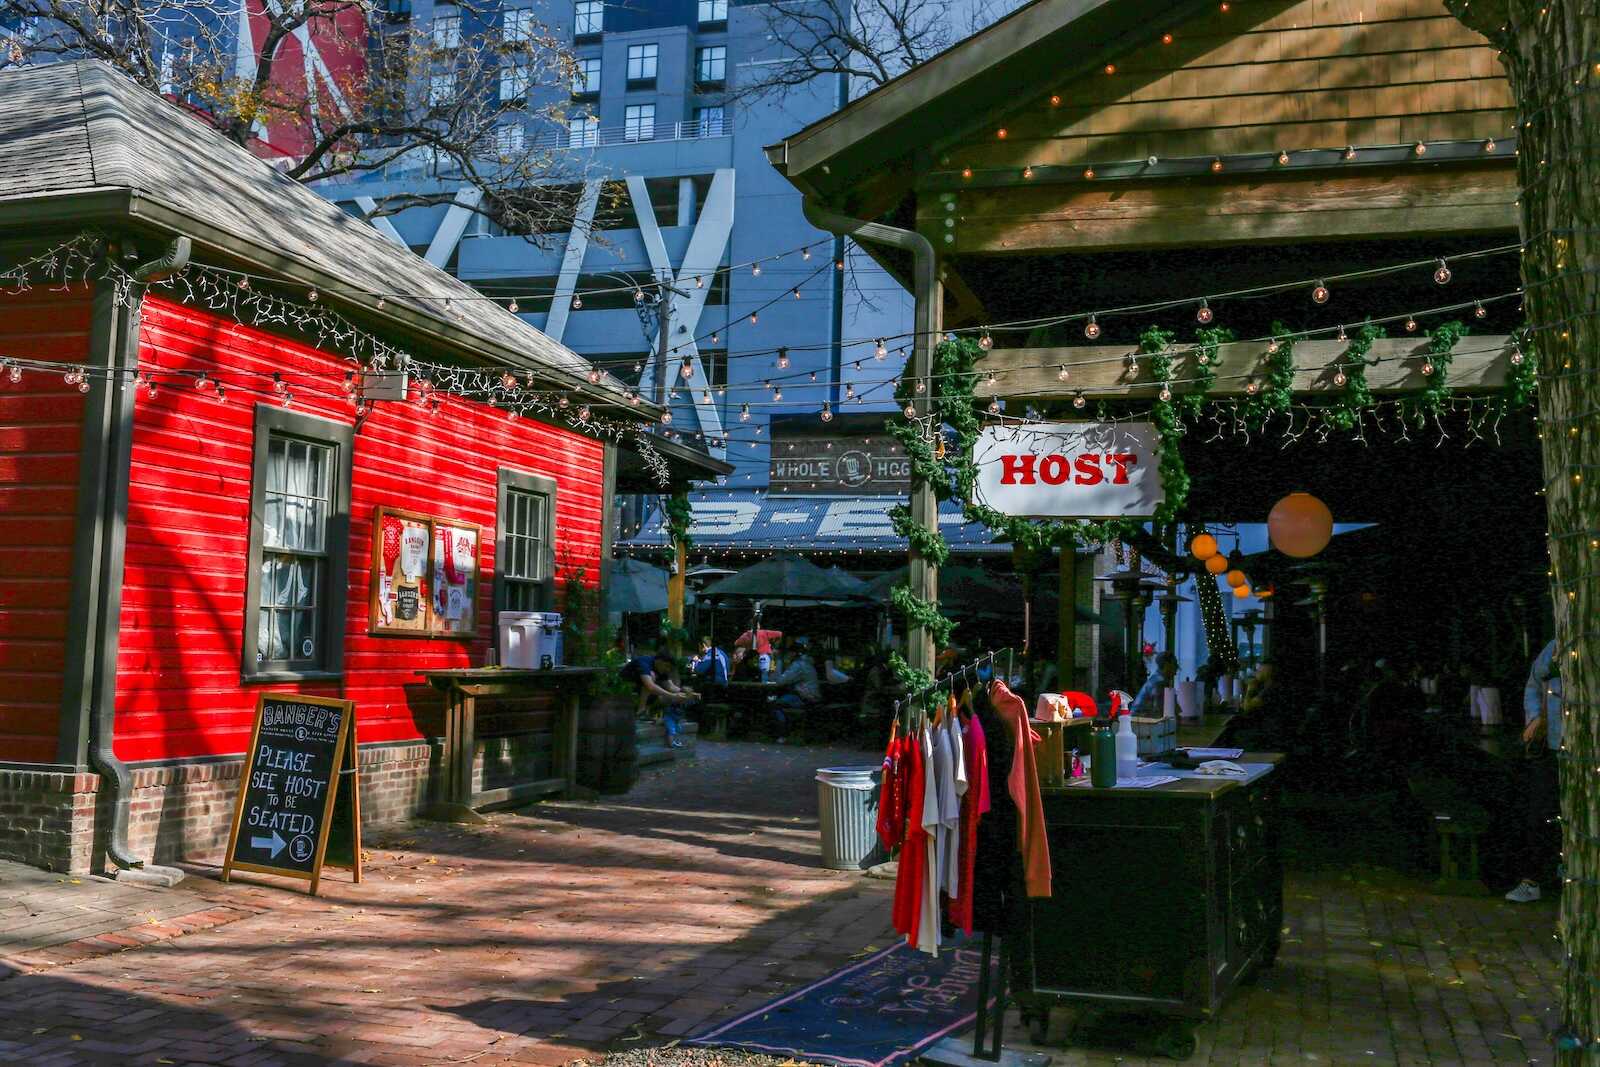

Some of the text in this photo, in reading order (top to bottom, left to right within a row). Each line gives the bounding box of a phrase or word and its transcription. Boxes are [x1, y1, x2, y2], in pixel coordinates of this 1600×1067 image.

[776, 462, 830, 477] WHOLE
[1000, 453, 1138, 486] HOST
[263, 704, 343, 734] BANGER'S
[257, 745, 315, 773] PLEASE
[252, 771, 326, 799] SEE HOST
[285, 795, 298, 809] BE
